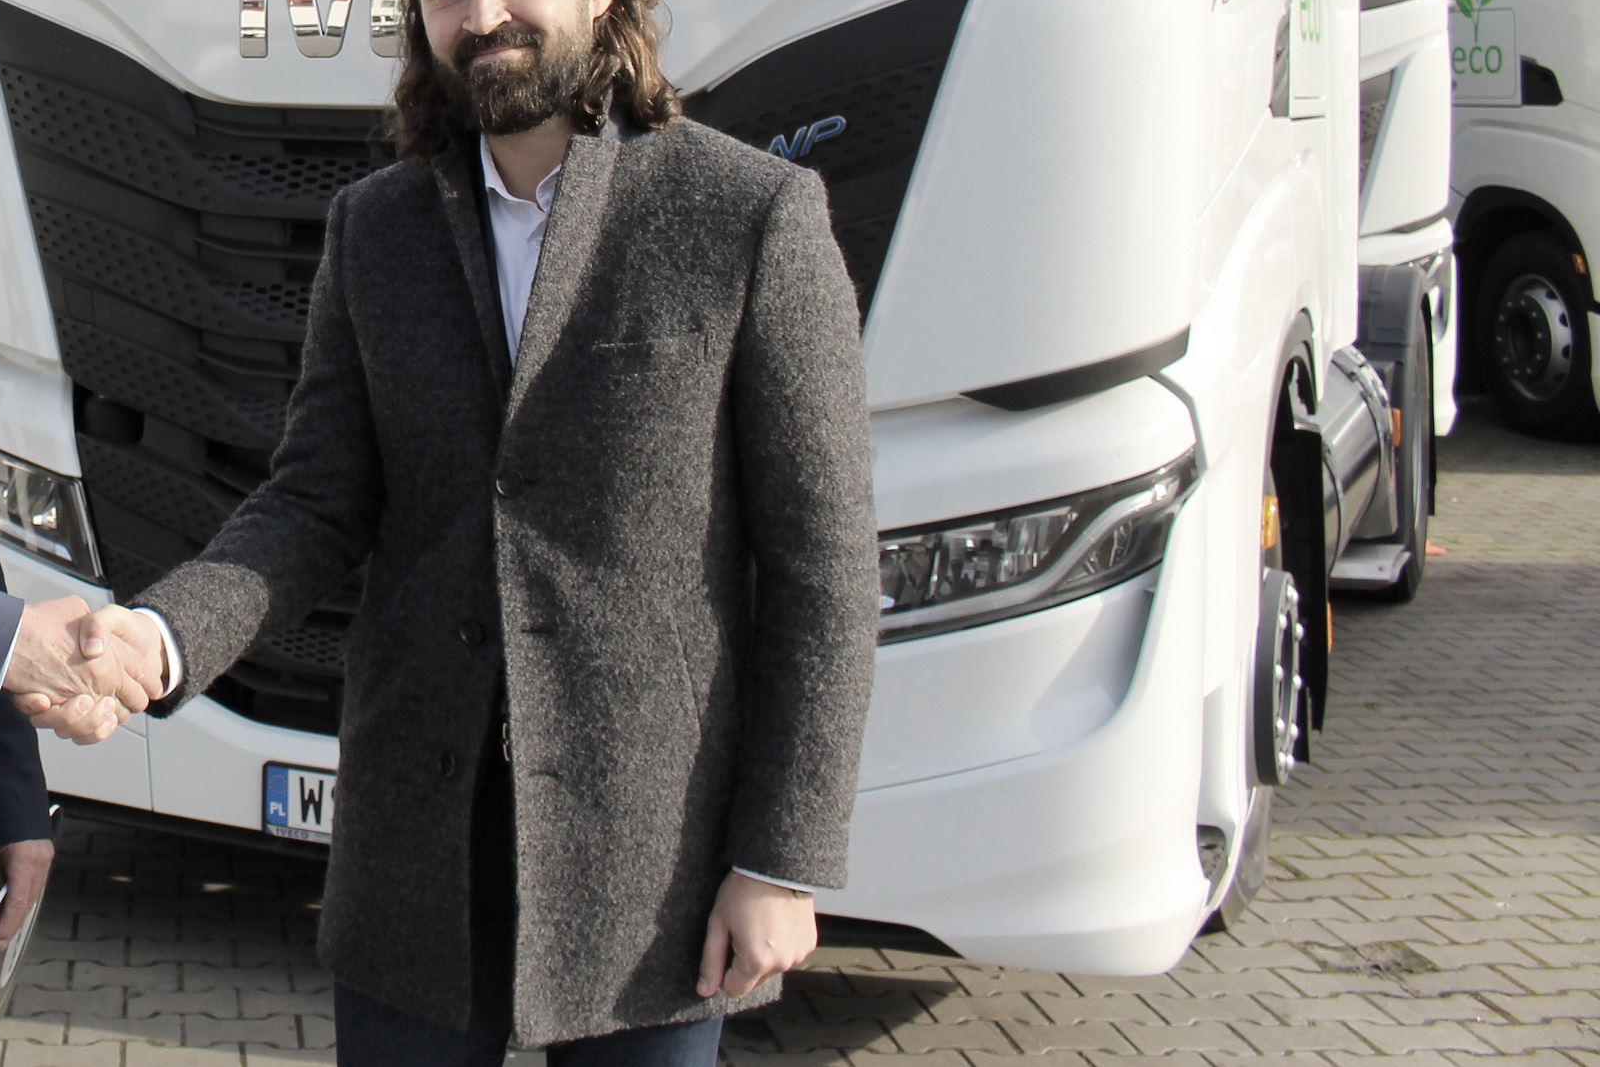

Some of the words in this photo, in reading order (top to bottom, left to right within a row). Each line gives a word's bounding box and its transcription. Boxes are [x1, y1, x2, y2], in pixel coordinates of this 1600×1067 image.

[1452, 45, 1503, 75] eco
[768, 115, 847, 161] NP
[269, 802, 286, 817] PL
[299, 776, 336, 825] W
